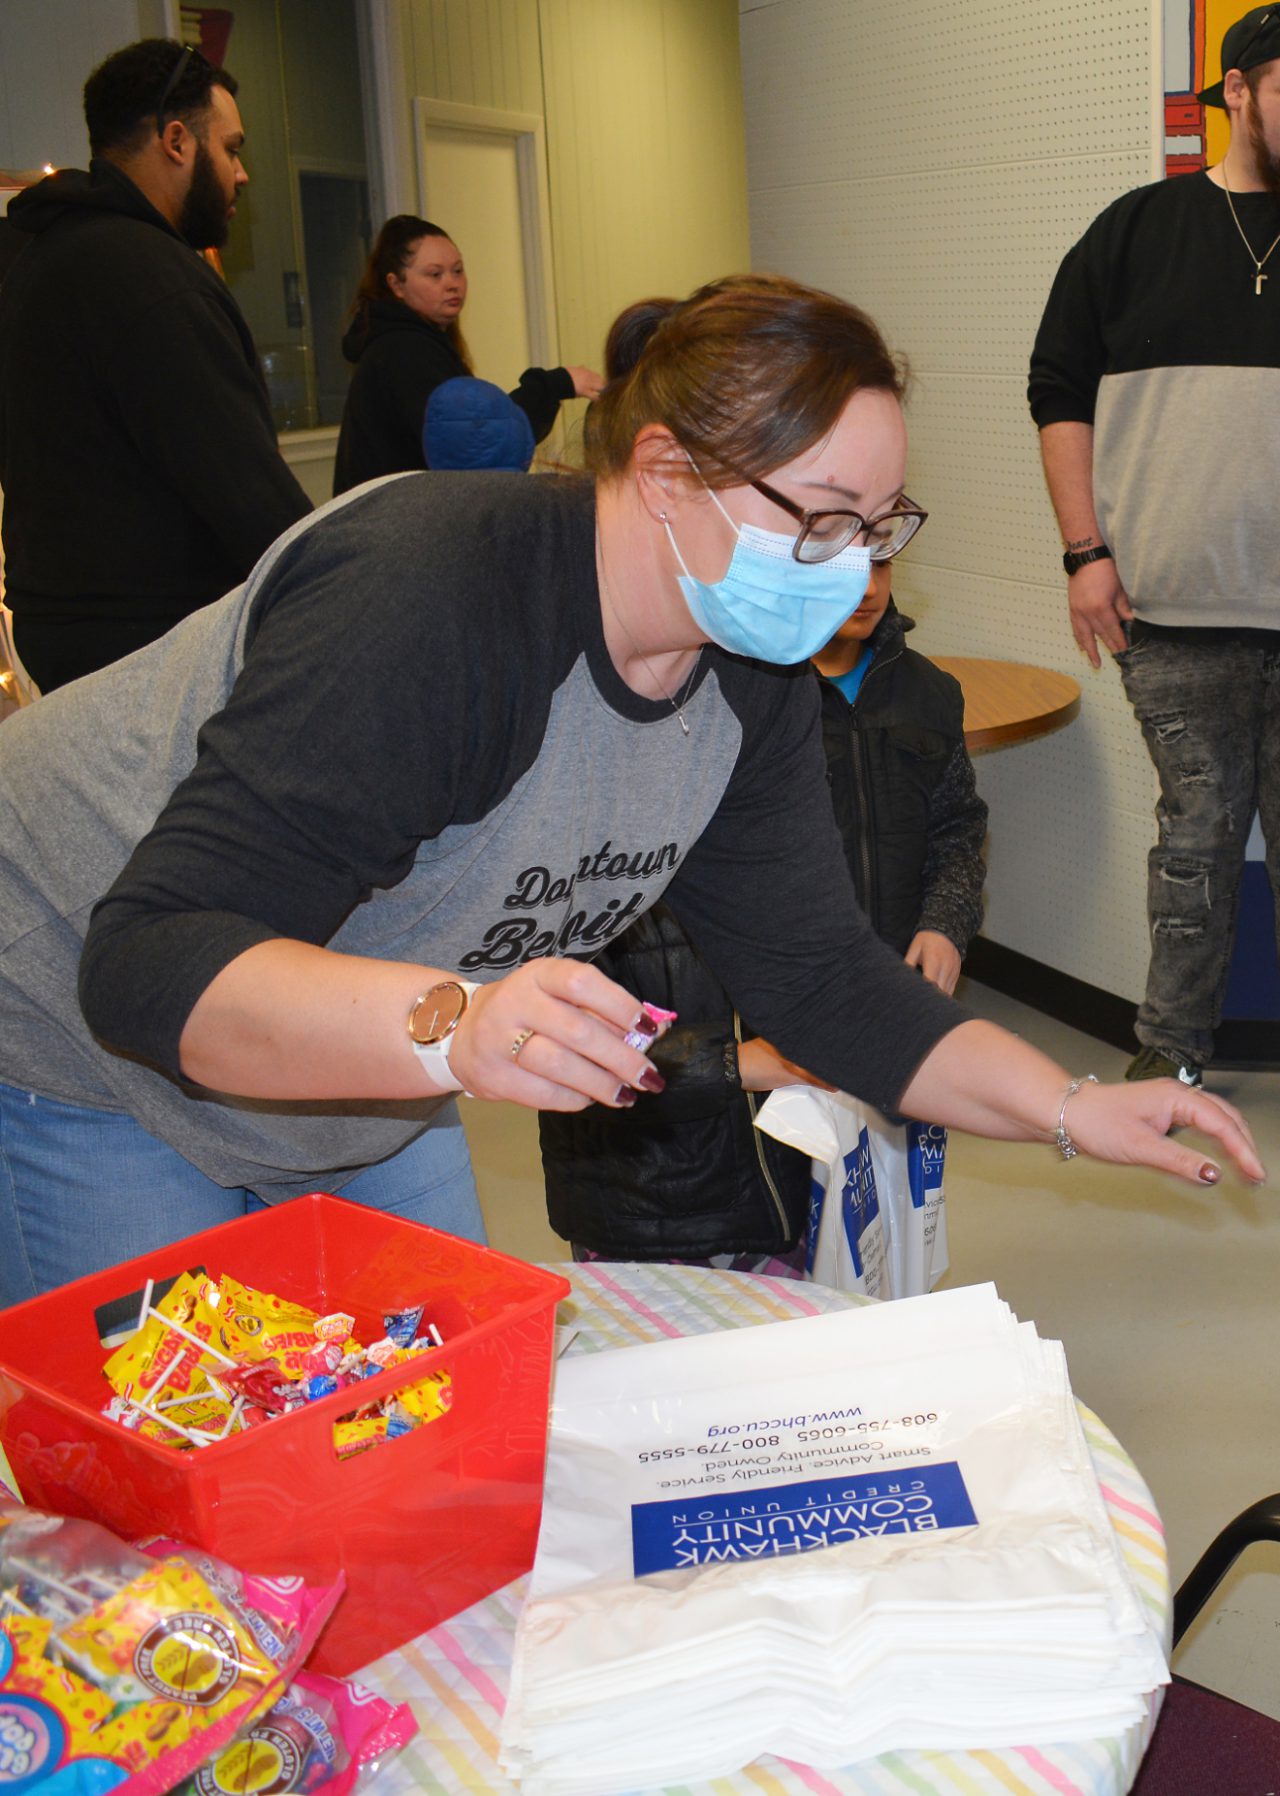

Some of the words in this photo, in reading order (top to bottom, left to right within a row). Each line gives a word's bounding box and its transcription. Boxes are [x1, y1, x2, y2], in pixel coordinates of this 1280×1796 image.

[458, 892, 645, 970] Beit
[707, 1407, 862, 1438] www.bhccu.org
[797, 1412, 939, 1442] 608-755-6065
[638, 1435, 780, 1464] 800-779-5555
[780, 1441, 884, 1461] Community
[809, 1453, 873, 1470] Advice.
[880, 1447, 931, 1461] Smart
[702, 1456, 772, 1472] Owned.
[732, 1463, 804, 1480] Friendly
[656, 1473, 727, 1488] Service.
[806, 1480, 925, 1507] CREDIT
[671, 1495, 934, 1546] COMMUNITY
[672, 1502, 781, 1525] UNION
[674, 1513, 939, 1568] BLACKHAWK
[259, 1634, 283, 1658] NET
[0, 1746, 30, 1775] BL
